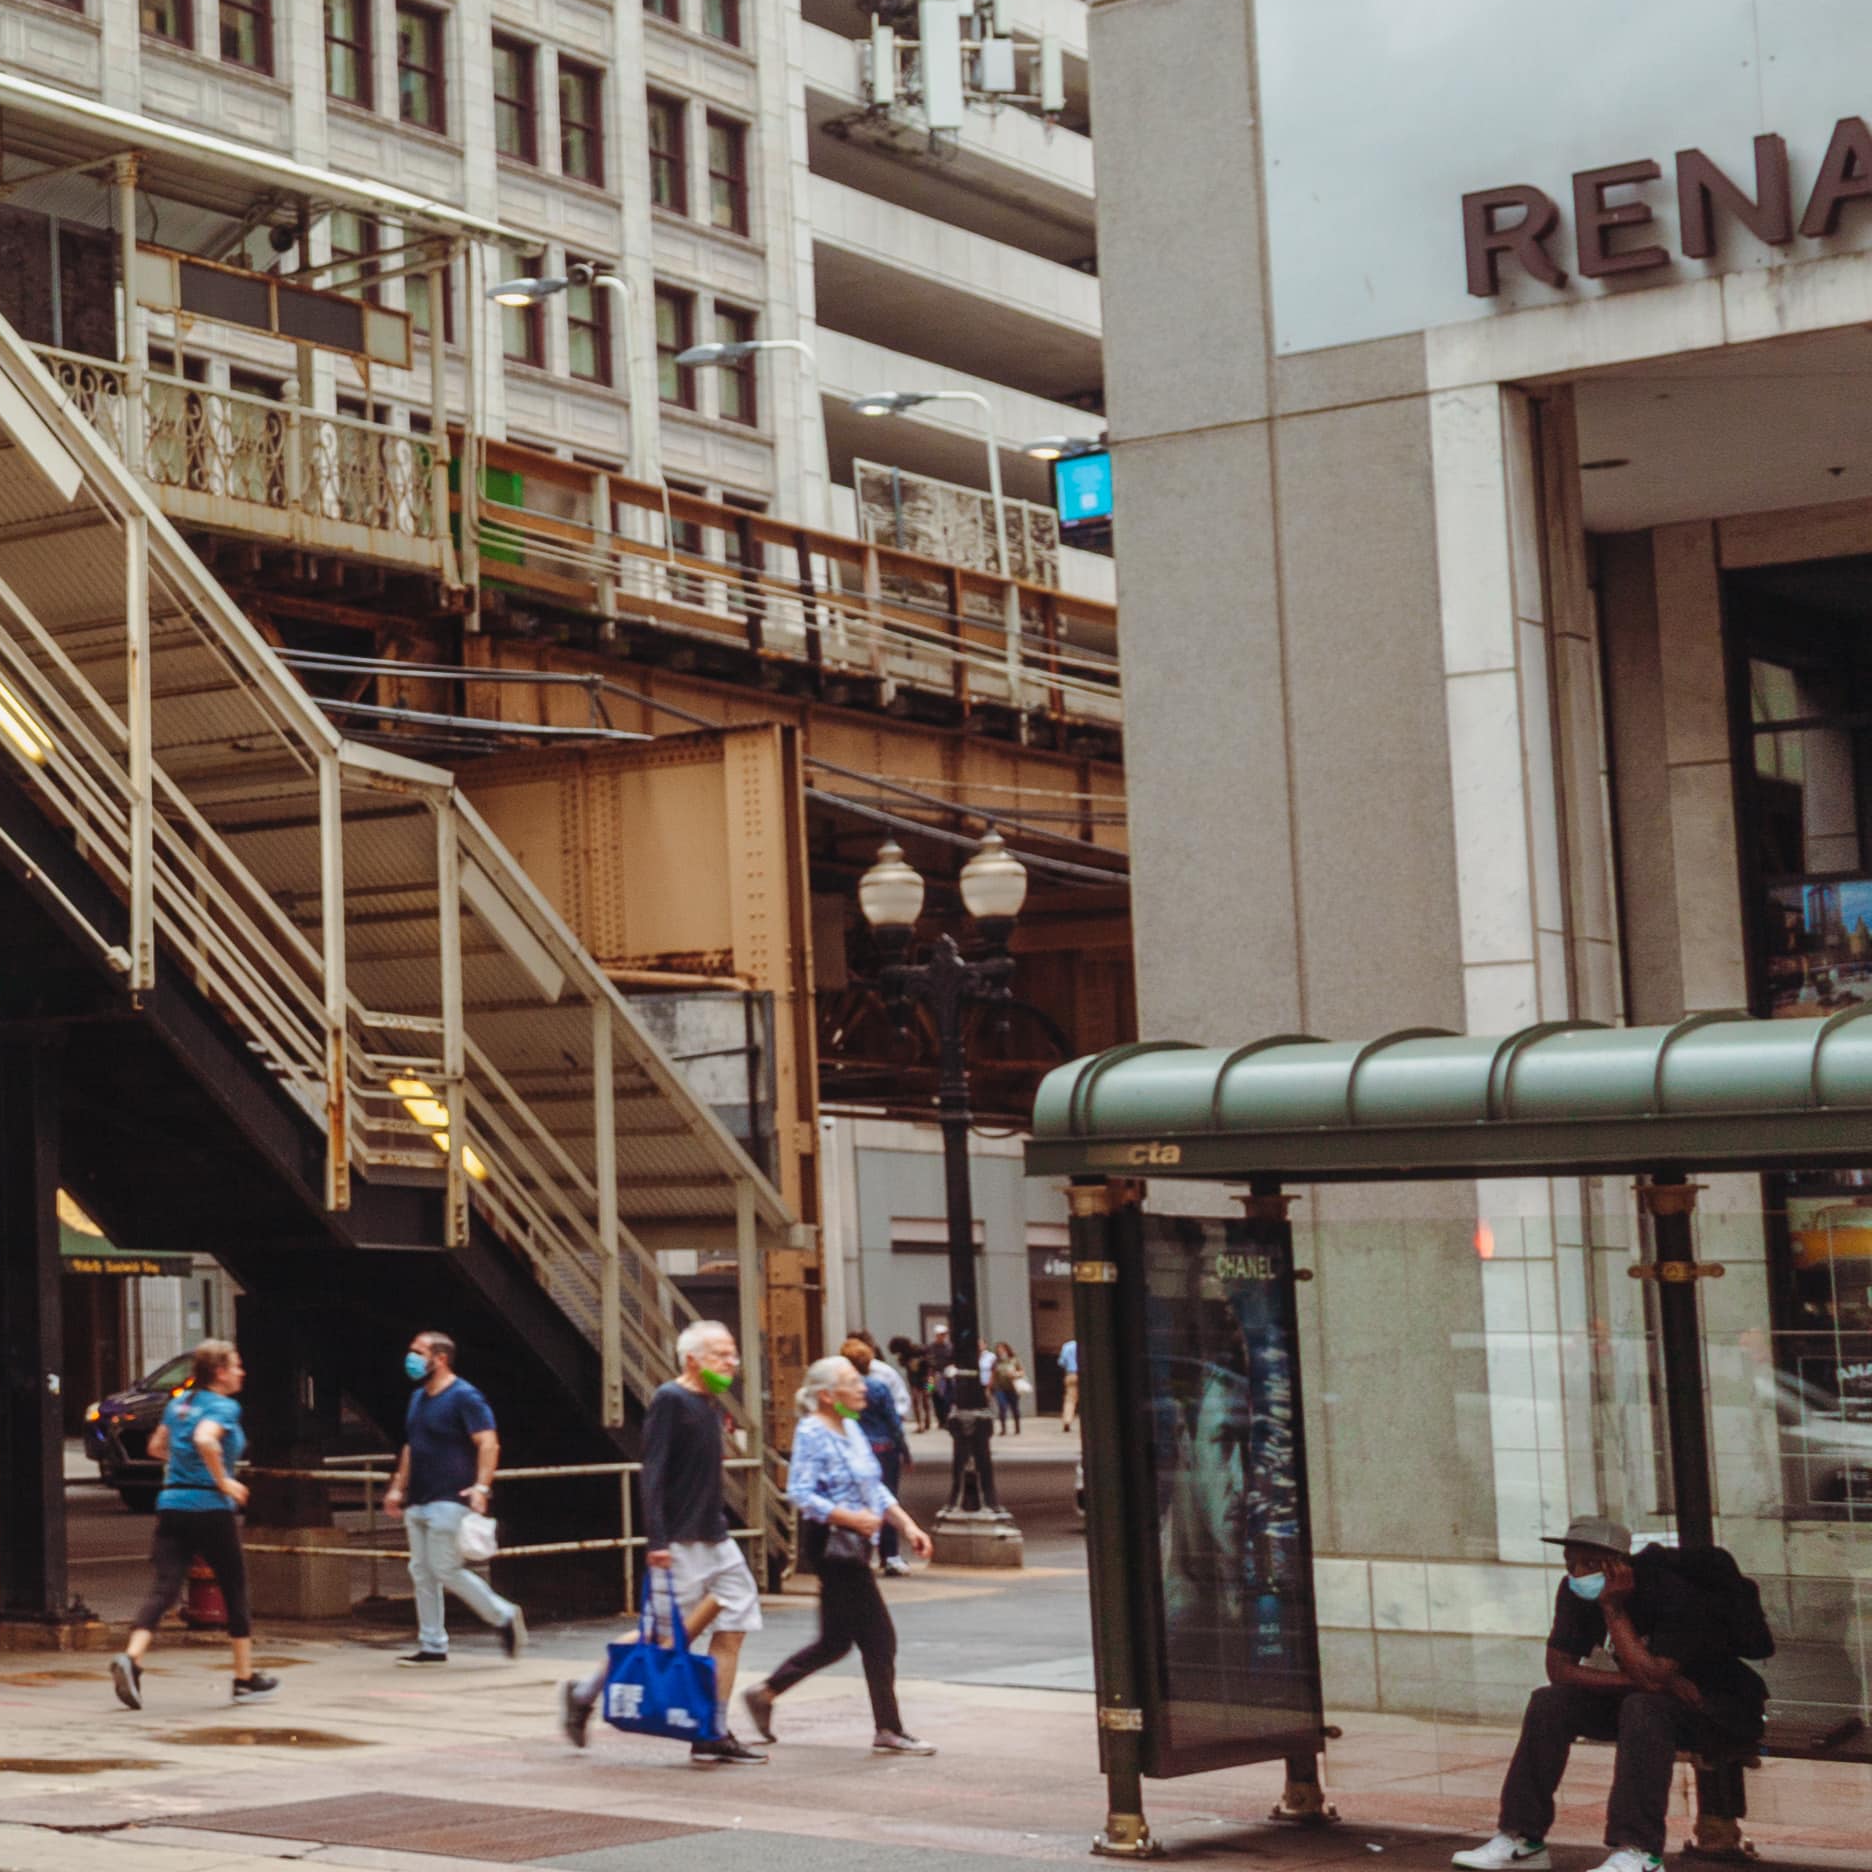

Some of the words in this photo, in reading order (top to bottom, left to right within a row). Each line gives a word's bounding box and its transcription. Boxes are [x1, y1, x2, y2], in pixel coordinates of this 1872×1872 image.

[1461, 114, 1872, 298] RENA
[1128, 1142, 1182, 1165] cta
[1215, 1253, 1276, 1279] CHANEL
